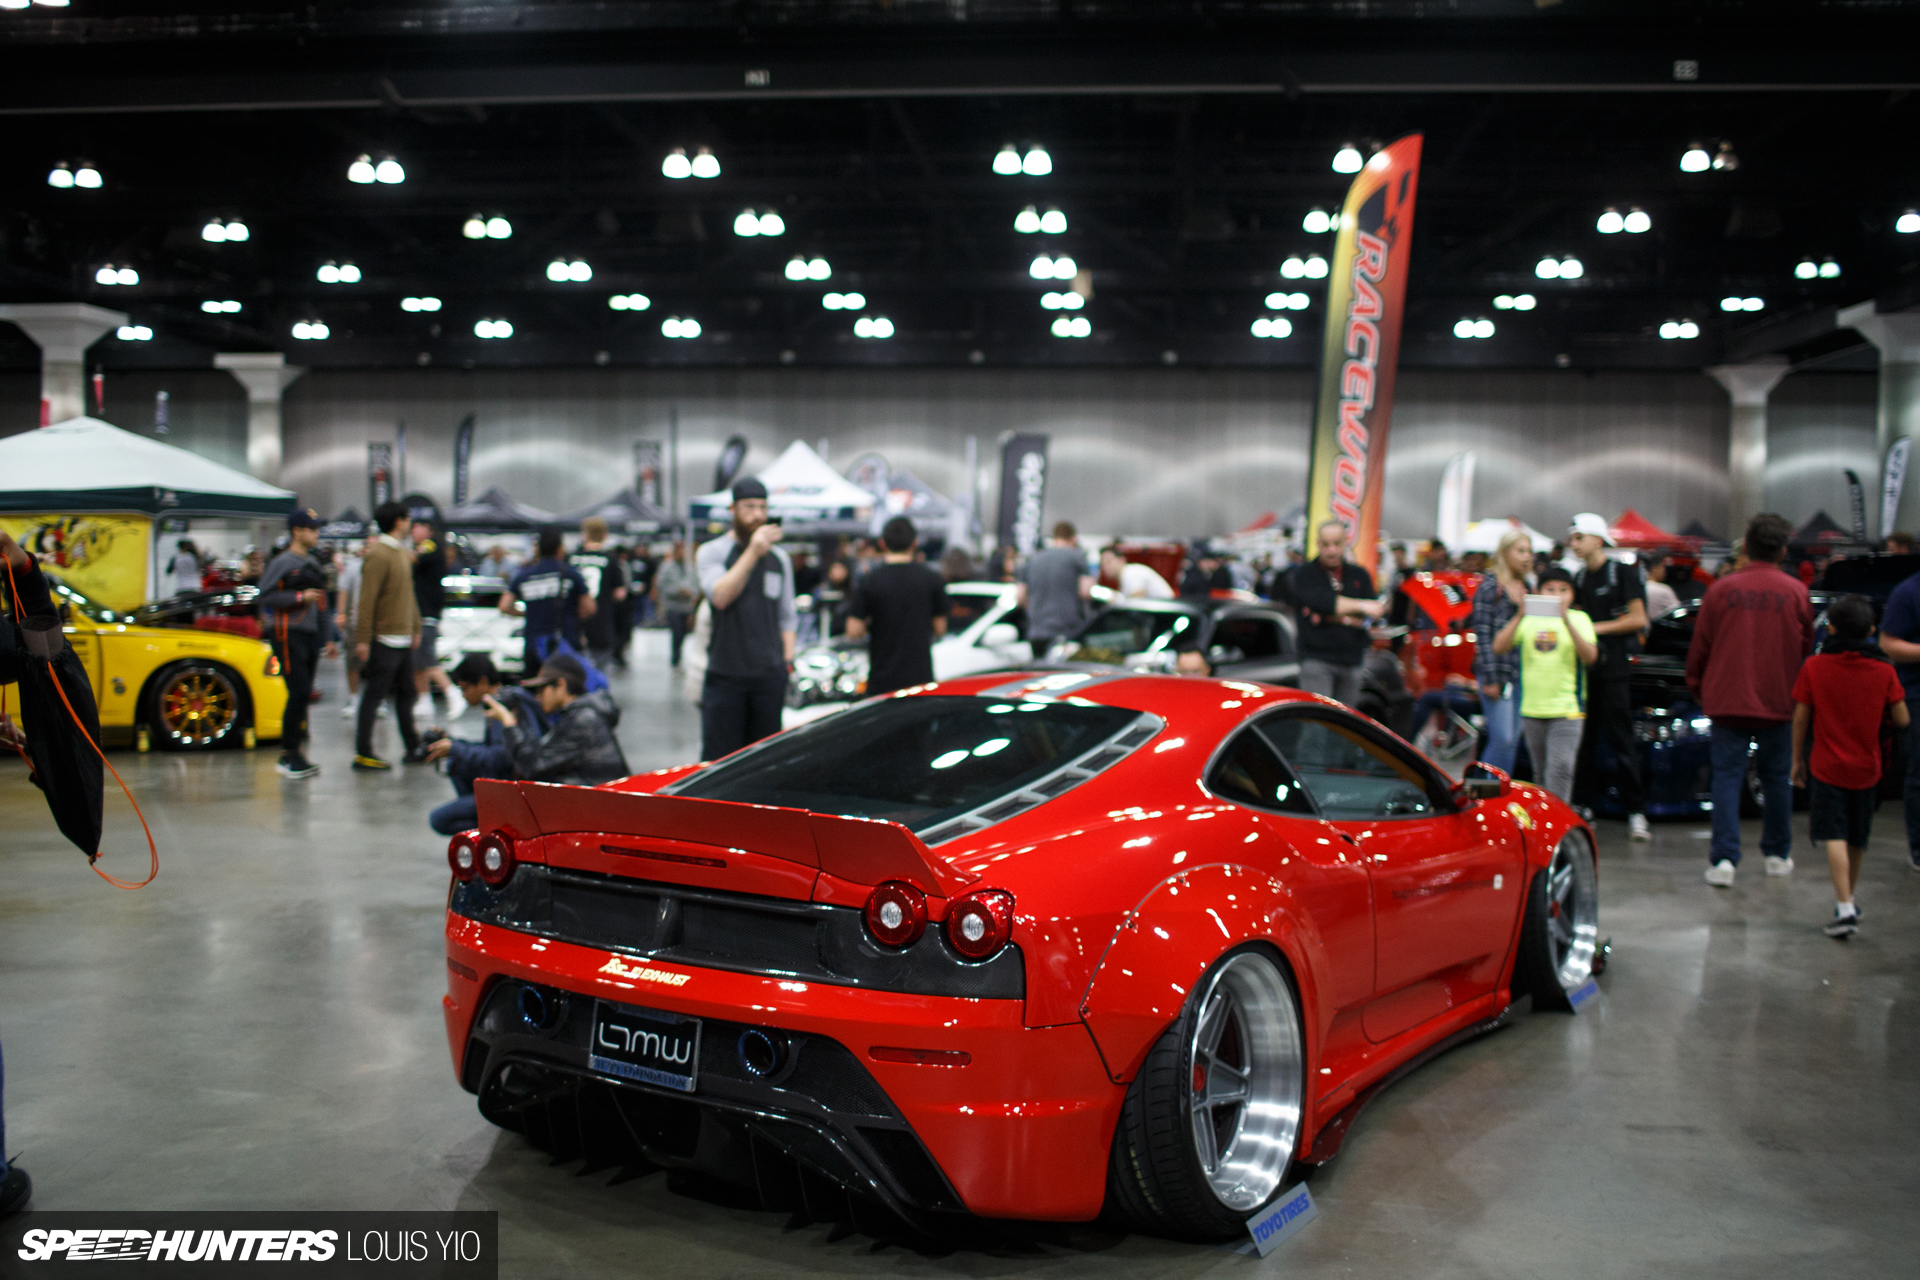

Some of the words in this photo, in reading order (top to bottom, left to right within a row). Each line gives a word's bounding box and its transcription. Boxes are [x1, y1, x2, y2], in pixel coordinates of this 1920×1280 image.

[1329, 229, 1389, 559] RACEWOR
[639, 968, 691, 986] EXHAUST
[1252, 1211, 1283, 1244] TOYO
[1280, 1191, 1311, 1224] TIRES
